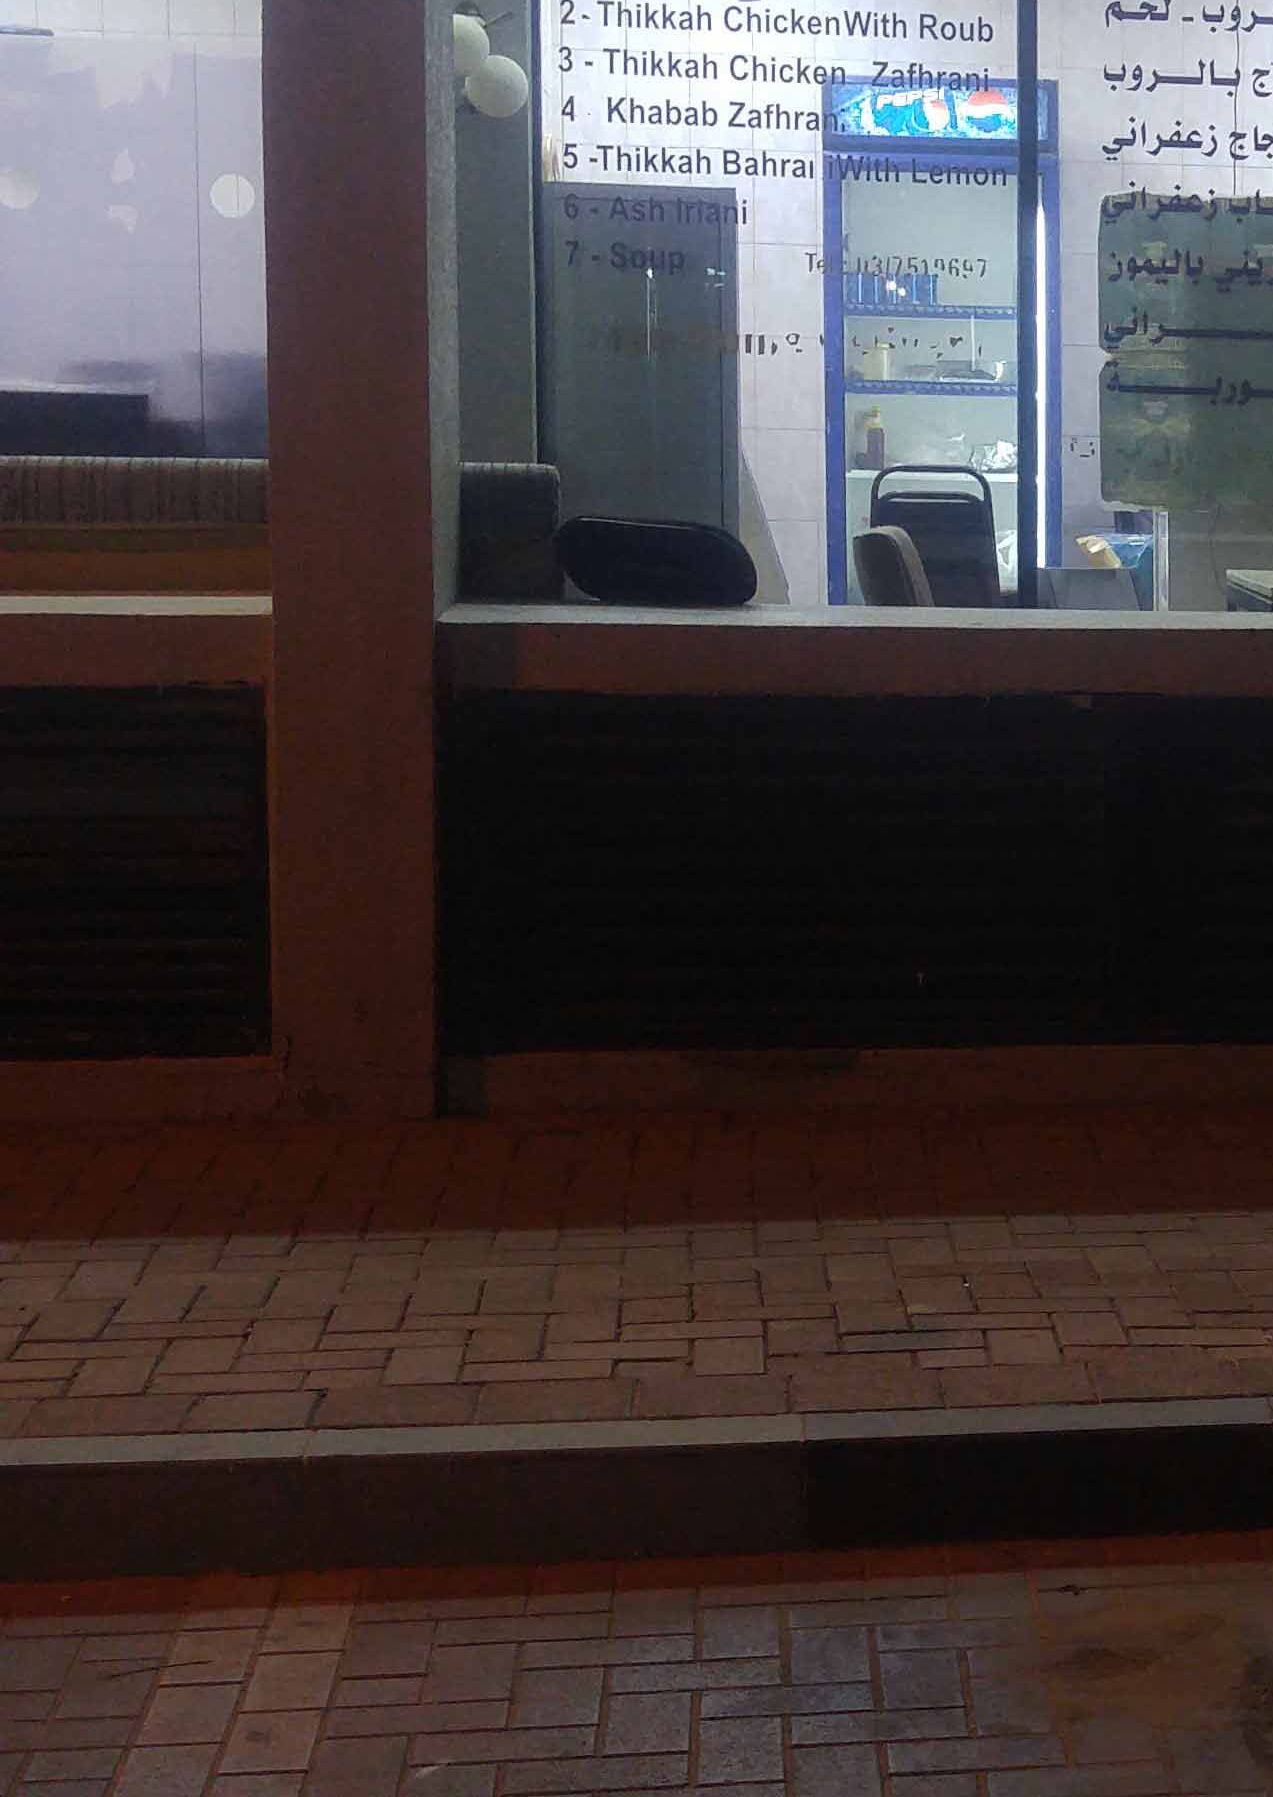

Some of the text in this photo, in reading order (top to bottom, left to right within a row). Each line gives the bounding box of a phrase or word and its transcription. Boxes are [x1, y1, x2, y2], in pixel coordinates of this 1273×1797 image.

[560, 0, 575, 26] 2
[597, 0, 711, 32] Thikkah
[920, 14, 994, 44] Roub
[558, 46, 573, 73] 3
[603, 48, 718, 80] Thikkah
[729, 54, 846, 86] Chicken
[607, 96, 718, 126] Khabab
[912, 158, 1007, 187] Lemon
[609, 195, 664, 223] Ash
[610, 242, 685, 276] Soup
